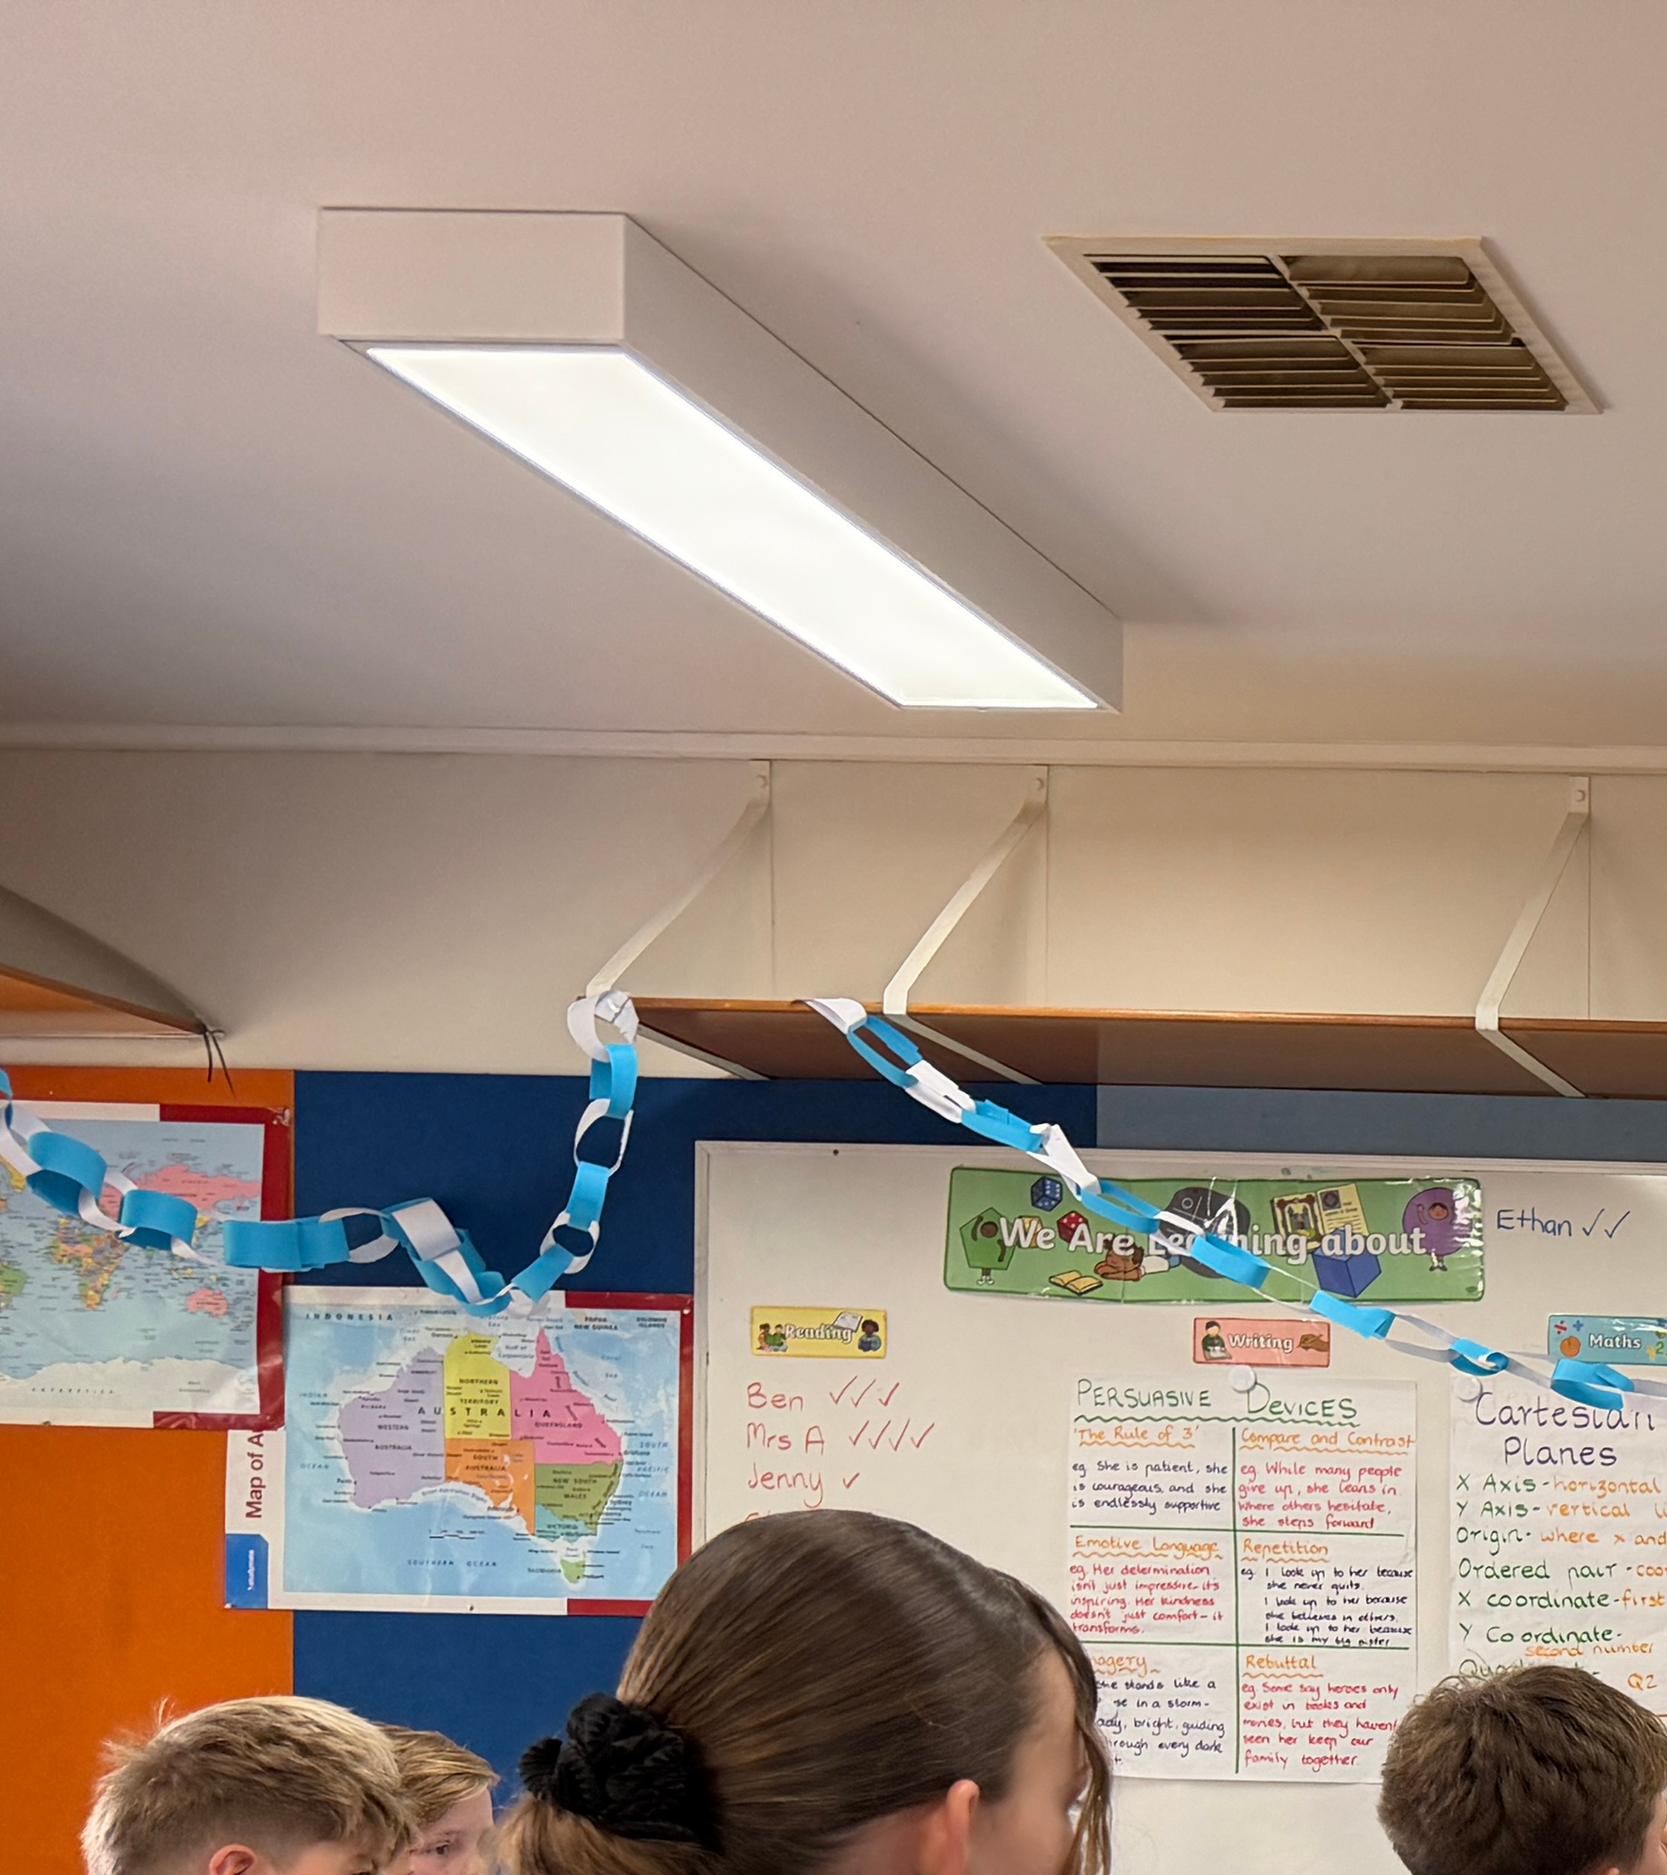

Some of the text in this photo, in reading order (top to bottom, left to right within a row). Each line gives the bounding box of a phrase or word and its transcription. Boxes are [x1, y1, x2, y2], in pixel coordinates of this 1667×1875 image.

[1497, 1207, 1572, 1237] Ethan
[1000, 1217, 1056, 1249] We
[1069, 1223, 1135, 1256] Are
[1321, 1226, 1426, 1256] about
[306, 1313, 393, 1321] INDONESIA
[784, 1324, 853, 1343] Reading
[1589, 1333, 1641, 1349] Maths
[1228, 1334, 1293, 1353] Writing
[747, 1382, 803, 1411] Ben
[1078, 1378, 1211, 1408] PERSUASIVE
[417, 1406, 552, 1418] AUSTRALIA
[747, 1422, 824, 1455] Mrs A
[1115, 1425, 1148, 1440] Rule
[1158, 1424, 1173, 1440] of
[1242, 1428, 1414, 1448] Compare and Contrast
[1504, 1437, 1617, 1466] Planes
[246, 1450, 264, 1519] Map of
[749, 1462, 823, 1508] Jenny
[1547, 1503, 1630, 1518] vertical
[1541, 1528, 1599, 1543] where
[1635, 1532, 1667, 1545] and
[1075, 1535, 1219, 1561] Emotive Language
[1243, 1538, 1328, 1557] Repetition
[1459, 1558, 1550, 1579] Ordered
[1569, 1564, 1617, 1589] pair
[1622, 1589, 1665, 1612] first
[1525, 1643, 1653, 1657] second number
[1246, 1655, 1316, 1669] Rebuttal
[1628, 1673, 1657, 1690] Q2
